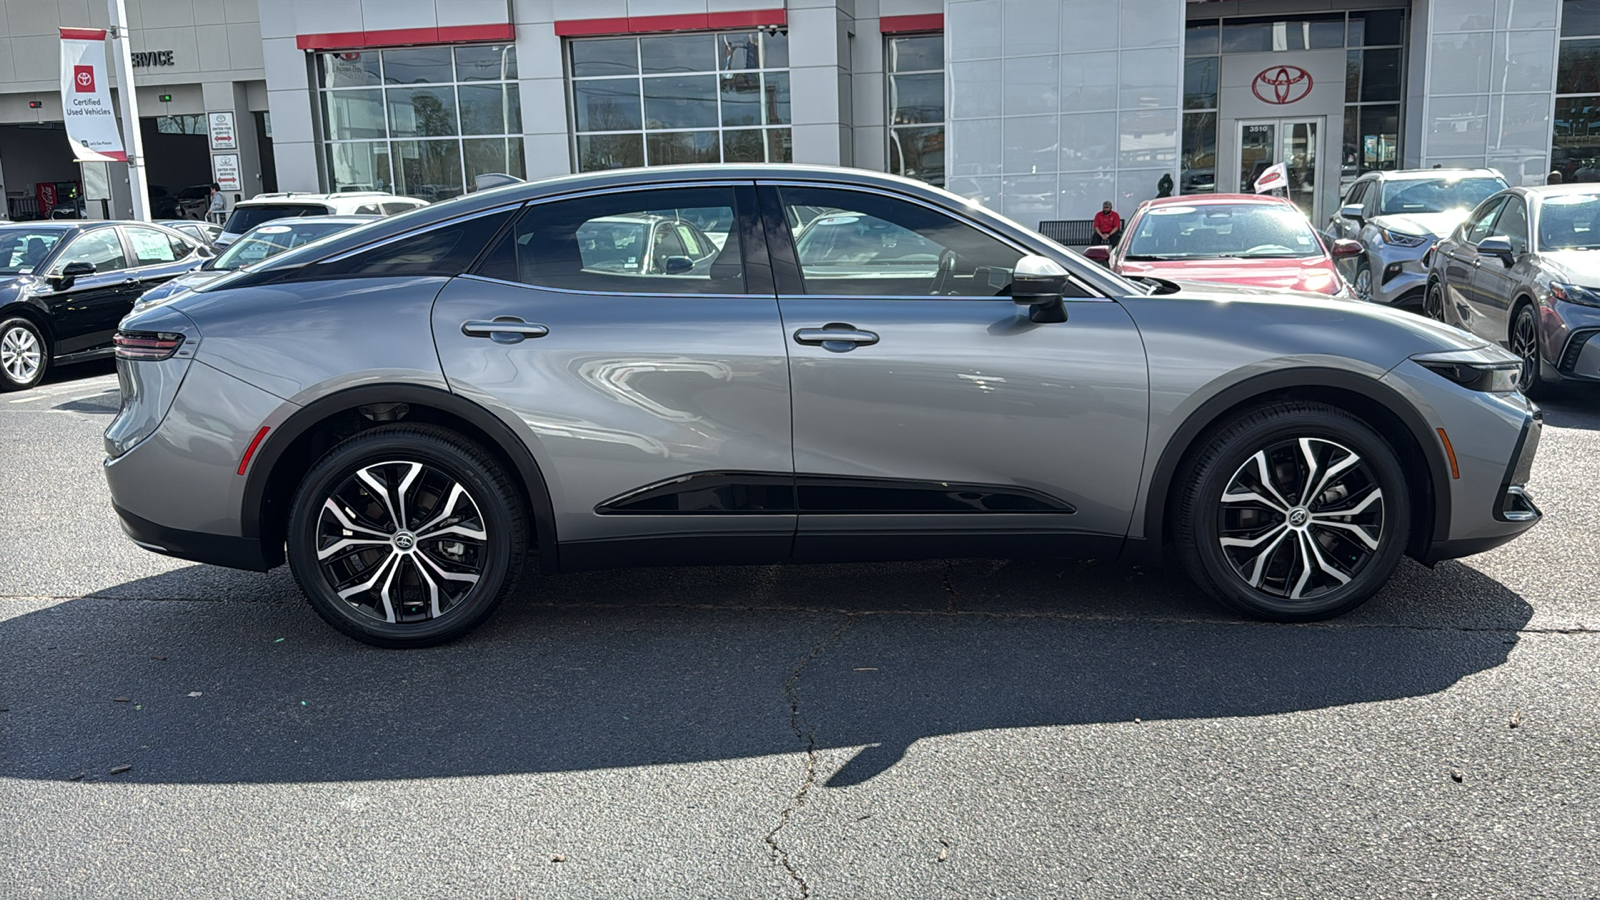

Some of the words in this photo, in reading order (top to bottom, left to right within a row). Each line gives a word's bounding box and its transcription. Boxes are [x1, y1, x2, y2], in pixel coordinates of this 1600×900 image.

[131, 50, 174, 67] ERVICE
[73, 98, 101, 106] Certified
[67, 108, 83, 116] Used
